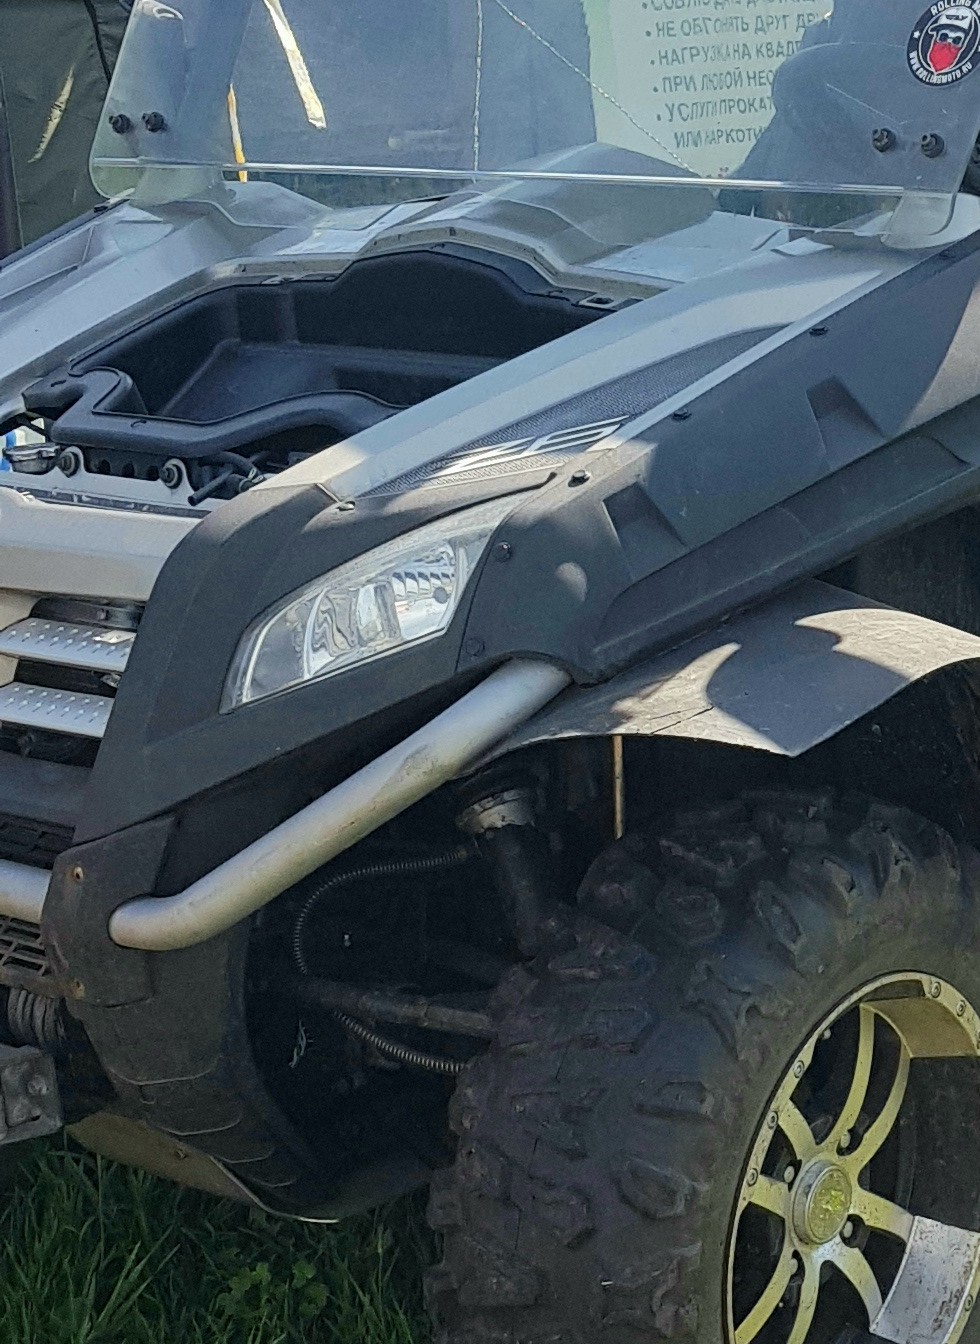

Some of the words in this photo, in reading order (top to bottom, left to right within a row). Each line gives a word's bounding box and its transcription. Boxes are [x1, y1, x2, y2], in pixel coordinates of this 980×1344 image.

[655, 20, 677, 38] НЕ
[754, 13, 789, 35] ДРУГ
[756, 40, 801, 58] КВАД
[662, 74, 697, 94] ПРИ
[719, 96, 772, 115] ПРОКАТ
[704, 125, 765, 145] НАРКОТИ
